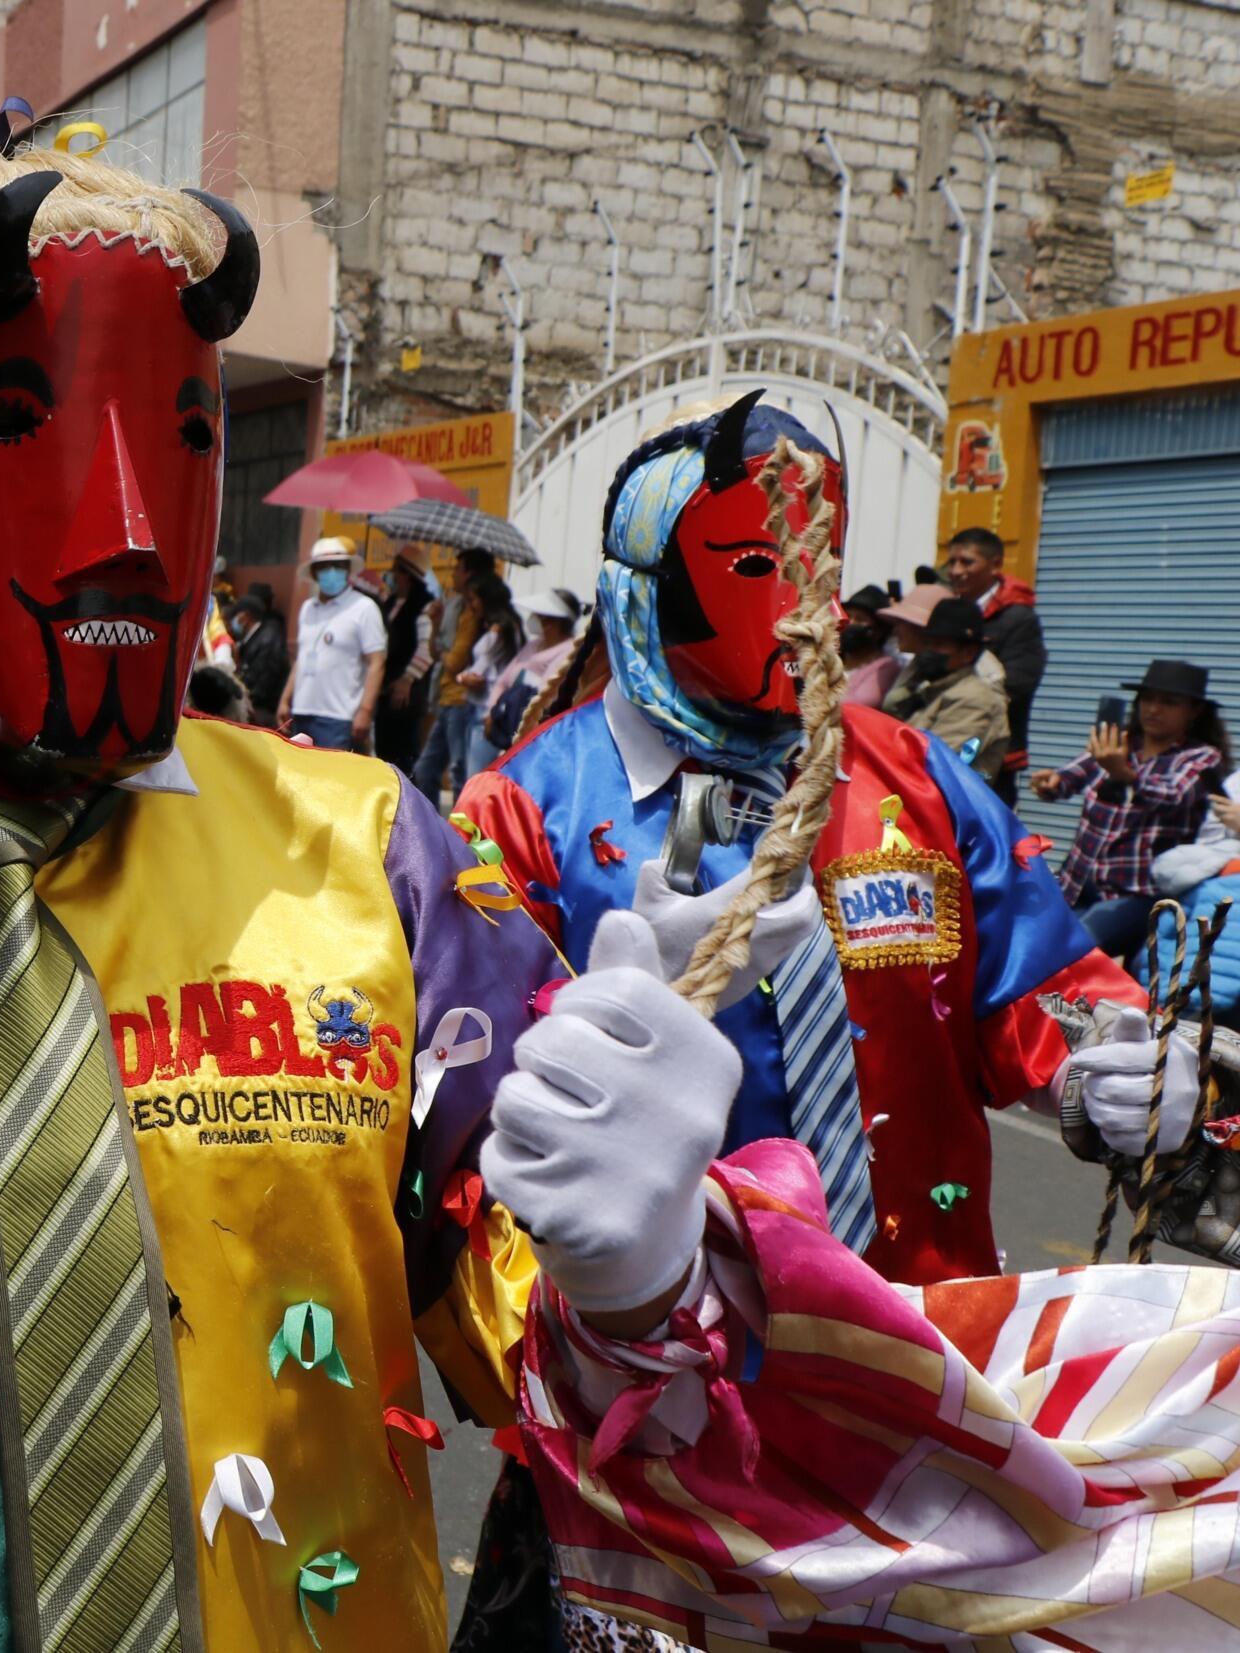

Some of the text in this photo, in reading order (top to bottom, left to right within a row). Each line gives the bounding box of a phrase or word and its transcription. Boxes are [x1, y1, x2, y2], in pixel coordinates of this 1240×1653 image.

[993, 326, 1101, 388] AUTO
[109, 980, 401, 1091] DIABLOS
[198, 1128, 273, 1145] RIOBAMBA
[290, 1127, 346, 1145] ECUADOR
